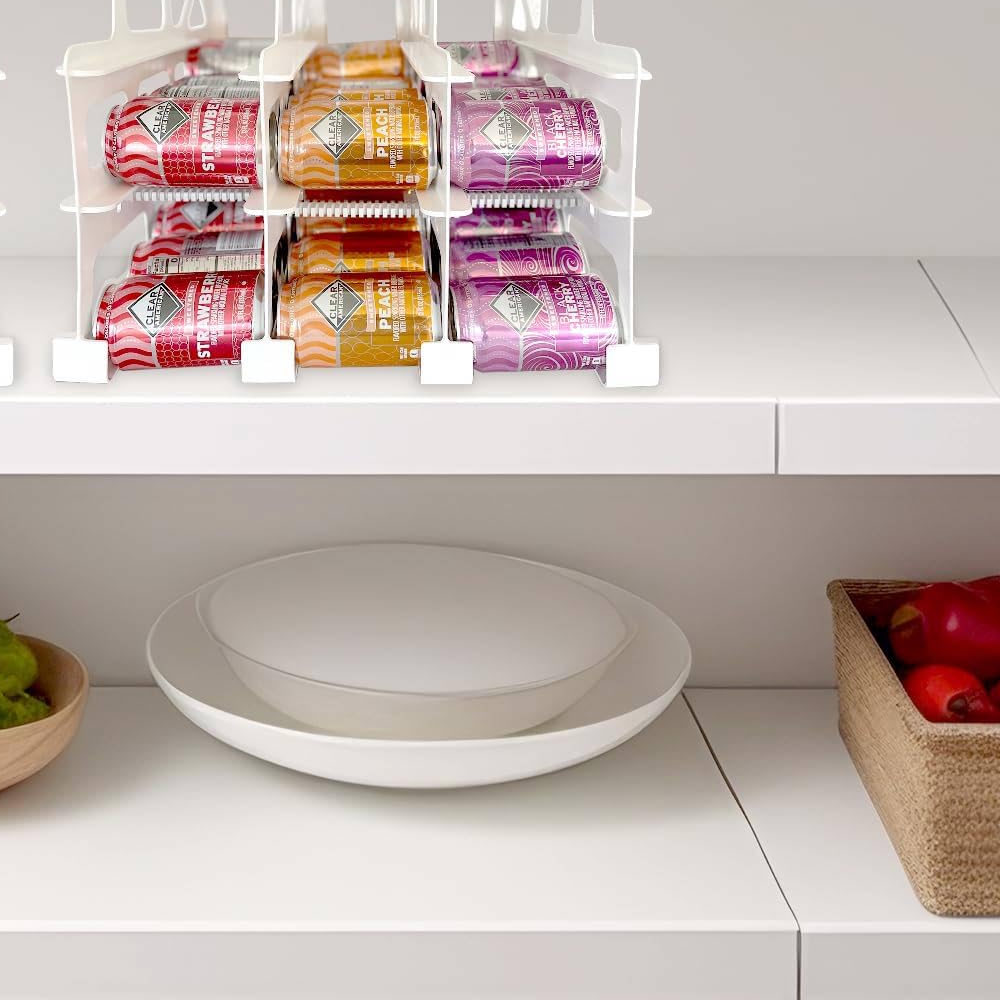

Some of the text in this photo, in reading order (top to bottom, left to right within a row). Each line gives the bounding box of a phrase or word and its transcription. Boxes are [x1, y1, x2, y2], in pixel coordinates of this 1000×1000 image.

[152, 105, 165, 134] CLEAR
[161, 104, 171, 134] AMERICAN
[376, 108, 388, 157] PEACH
[498, 116, 507, 149] CLEAR
[505, 113, 513, 149] AMERICAN
[544, 113, 557, 150] BLACK
[551, 108, 567, 158] CHERRY
[146, 291, 158, 326] CLEAR
[155, 289, 164, 326] AMERICAN
[378, 279, 391, 329] PEACH
[507, 290, 518, 322] CLEAR
[514, 287, 525, 322] AMERICAN
[552, 287, 570, 324] BLACK
[559, 282, 581, 333] CHERRY
